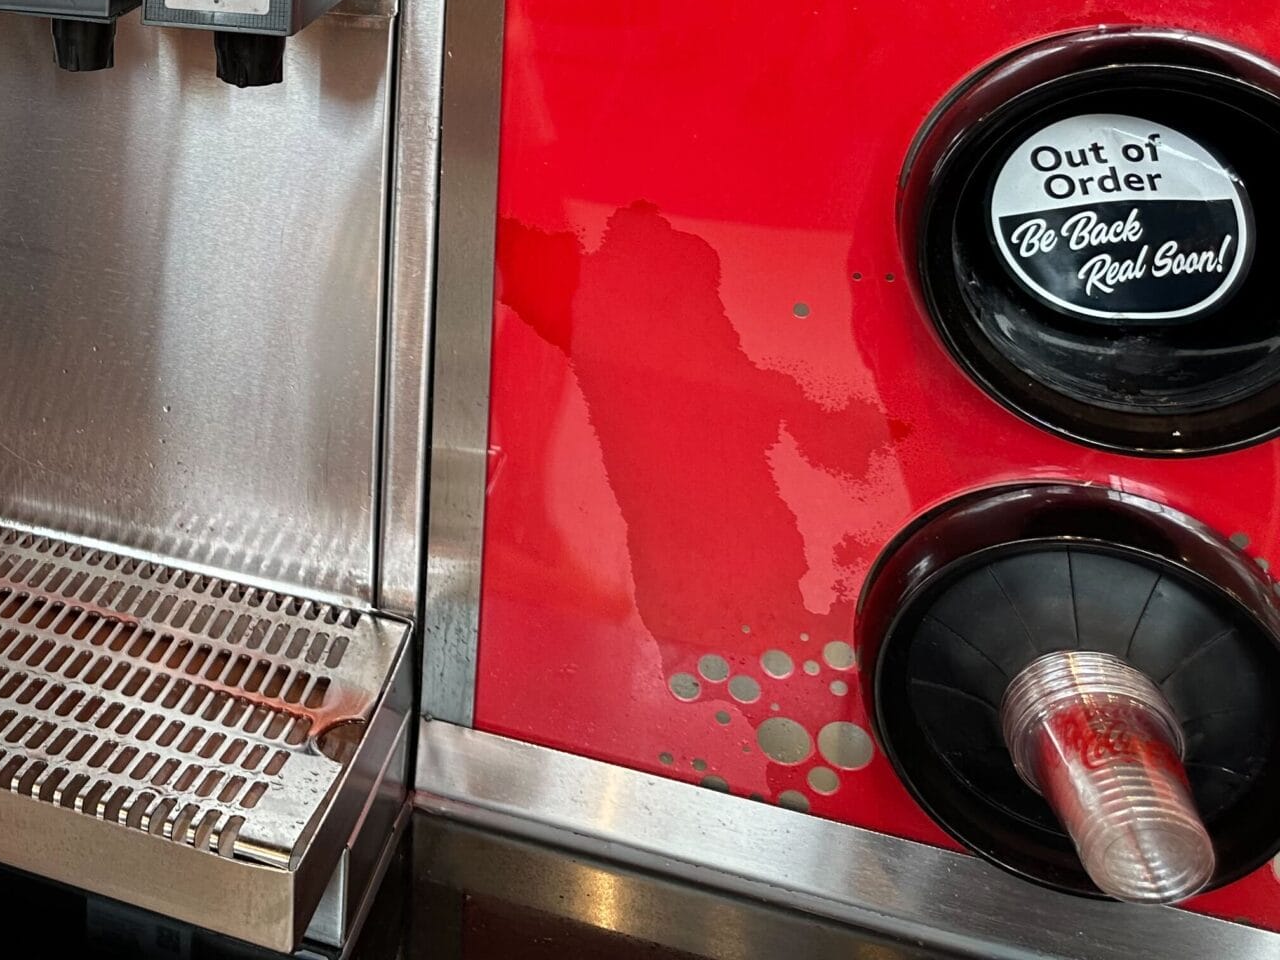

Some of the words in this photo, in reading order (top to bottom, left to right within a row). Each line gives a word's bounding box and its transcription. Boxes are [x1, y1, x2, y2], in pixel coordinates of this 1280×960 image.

[1030, 142, 1108, 172] Out
[1121, 134, 1161, 162] of
[1043, 166, 1162, 200] Order
[1011, 218, 1058, 258] Be
[1061, 208, 1143, 251] Back
[1078, 244, 1149, 296] Real
[1151, 234, 1233, 279] Soon!
